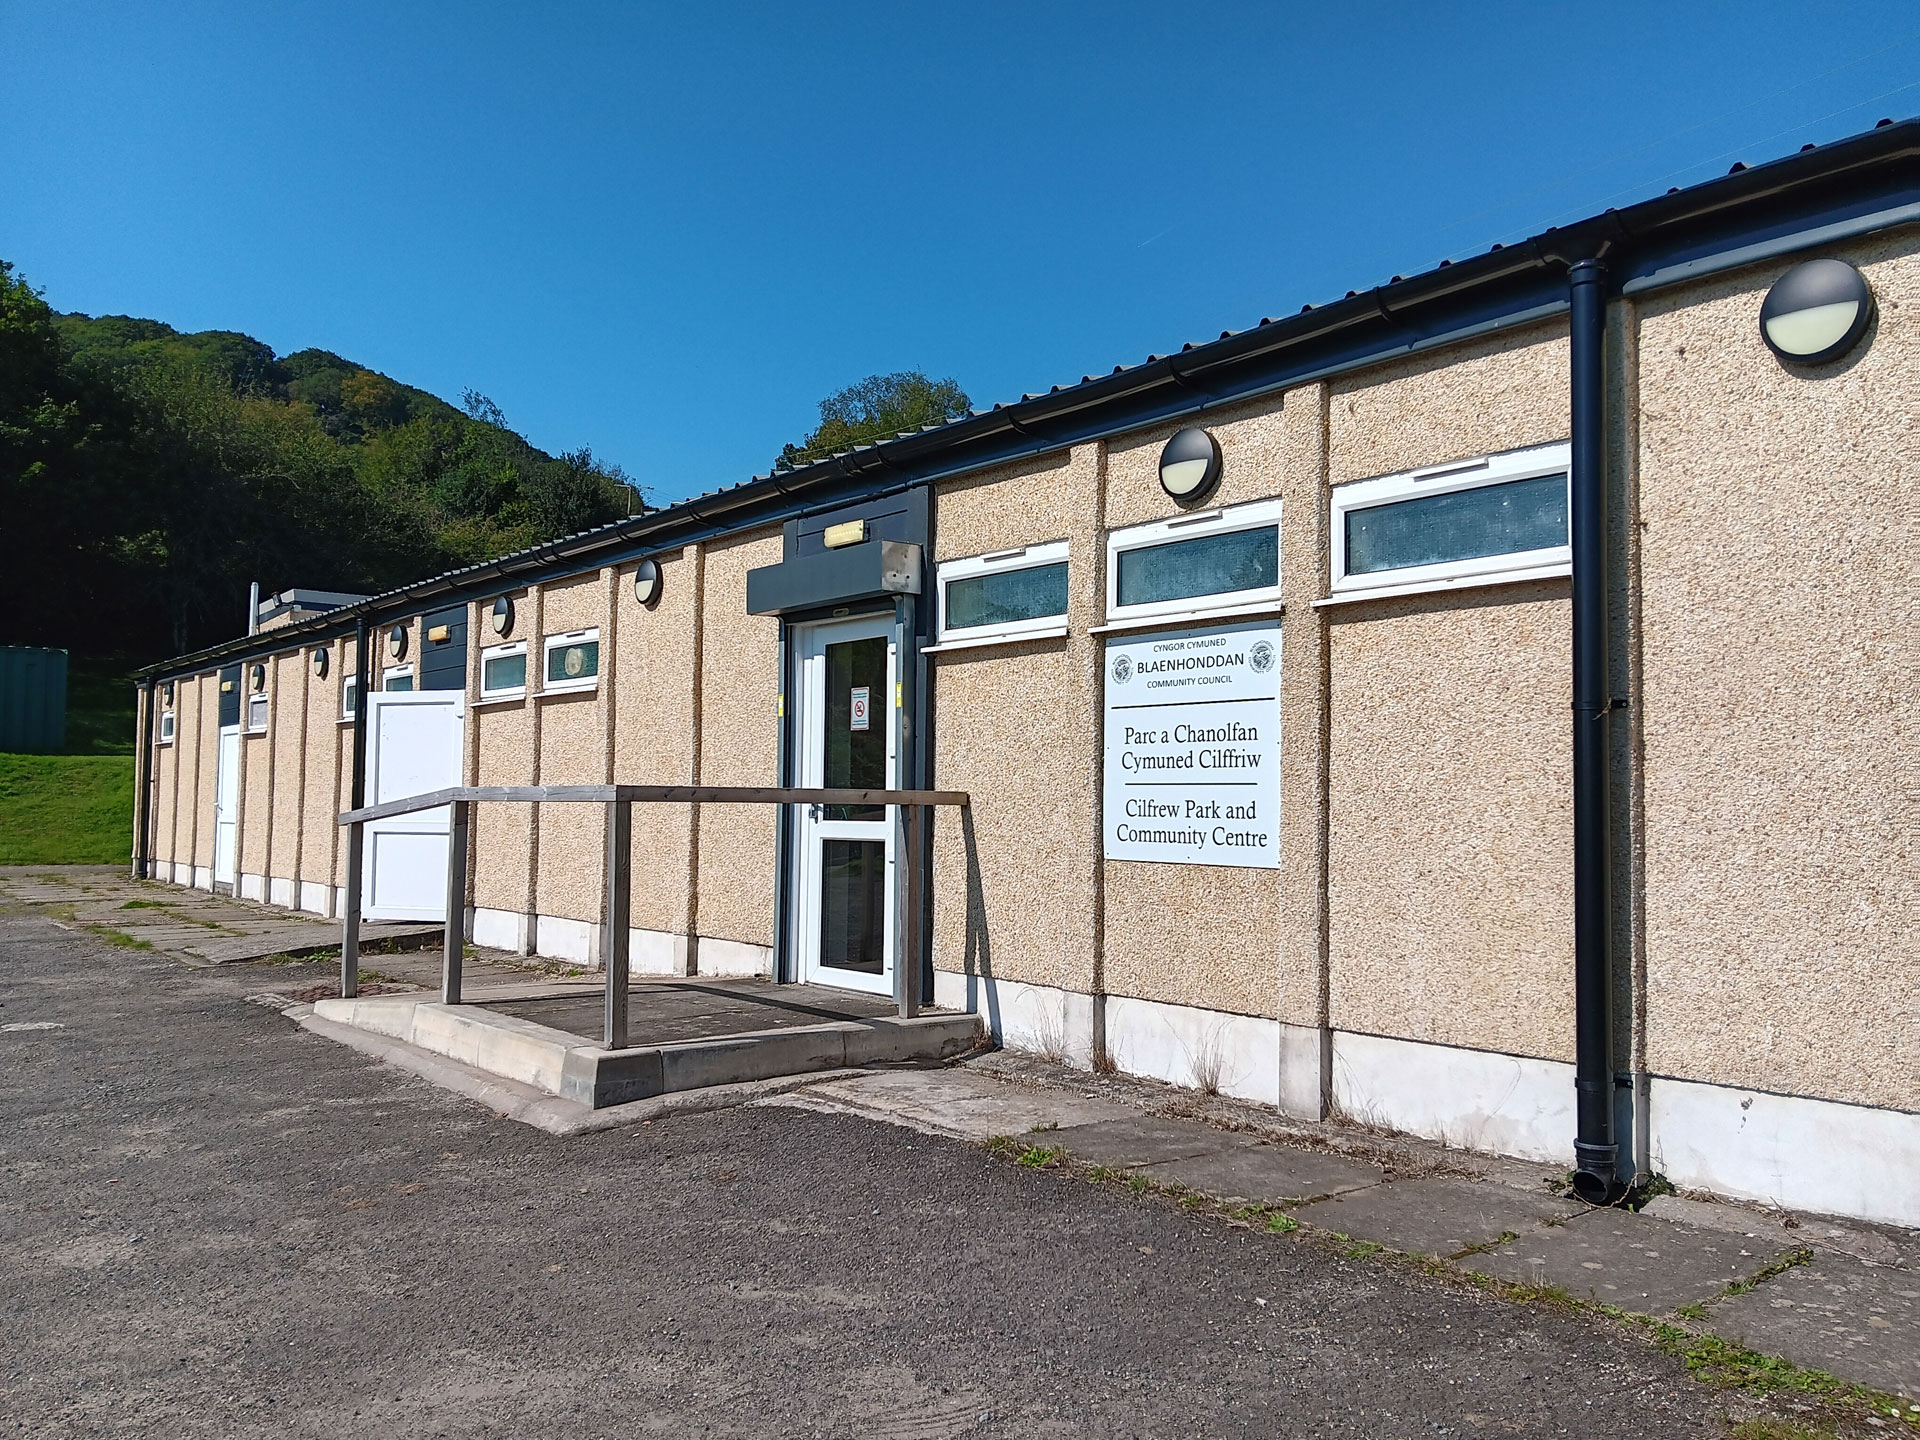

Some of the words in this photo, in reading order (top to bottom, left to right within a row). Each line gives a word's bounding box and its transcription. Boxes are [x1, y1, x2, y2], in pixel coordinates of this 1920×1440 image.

[1153, 642, 1185, 653] CYNGOR
[1187, 637, 1227, 650] CYMUNED
[1137, 653, 1244, 674] BLAENHONDDAN
[1147, 678, 1196, 689] COMMUNITY
[1197, 675, 1233, 686] COUNCIL
[1124, 727, 1156, 745] Parc
[1160, 729, 1169, 744] a
[1174, 721, 1259, 743] Chanolfan
[1121, 750, 1194, 774] Cymuned
[1198, 748, 1262, 769] Cilffriw
[1125, 798, 1180, 818] Cilfrew
[1185, 799, 1221, 819] Park
[1225, 800, 1257, 820] and
[1116, 823, 1207, 850] Community
[1212, 826, 1268, 848] Centre
